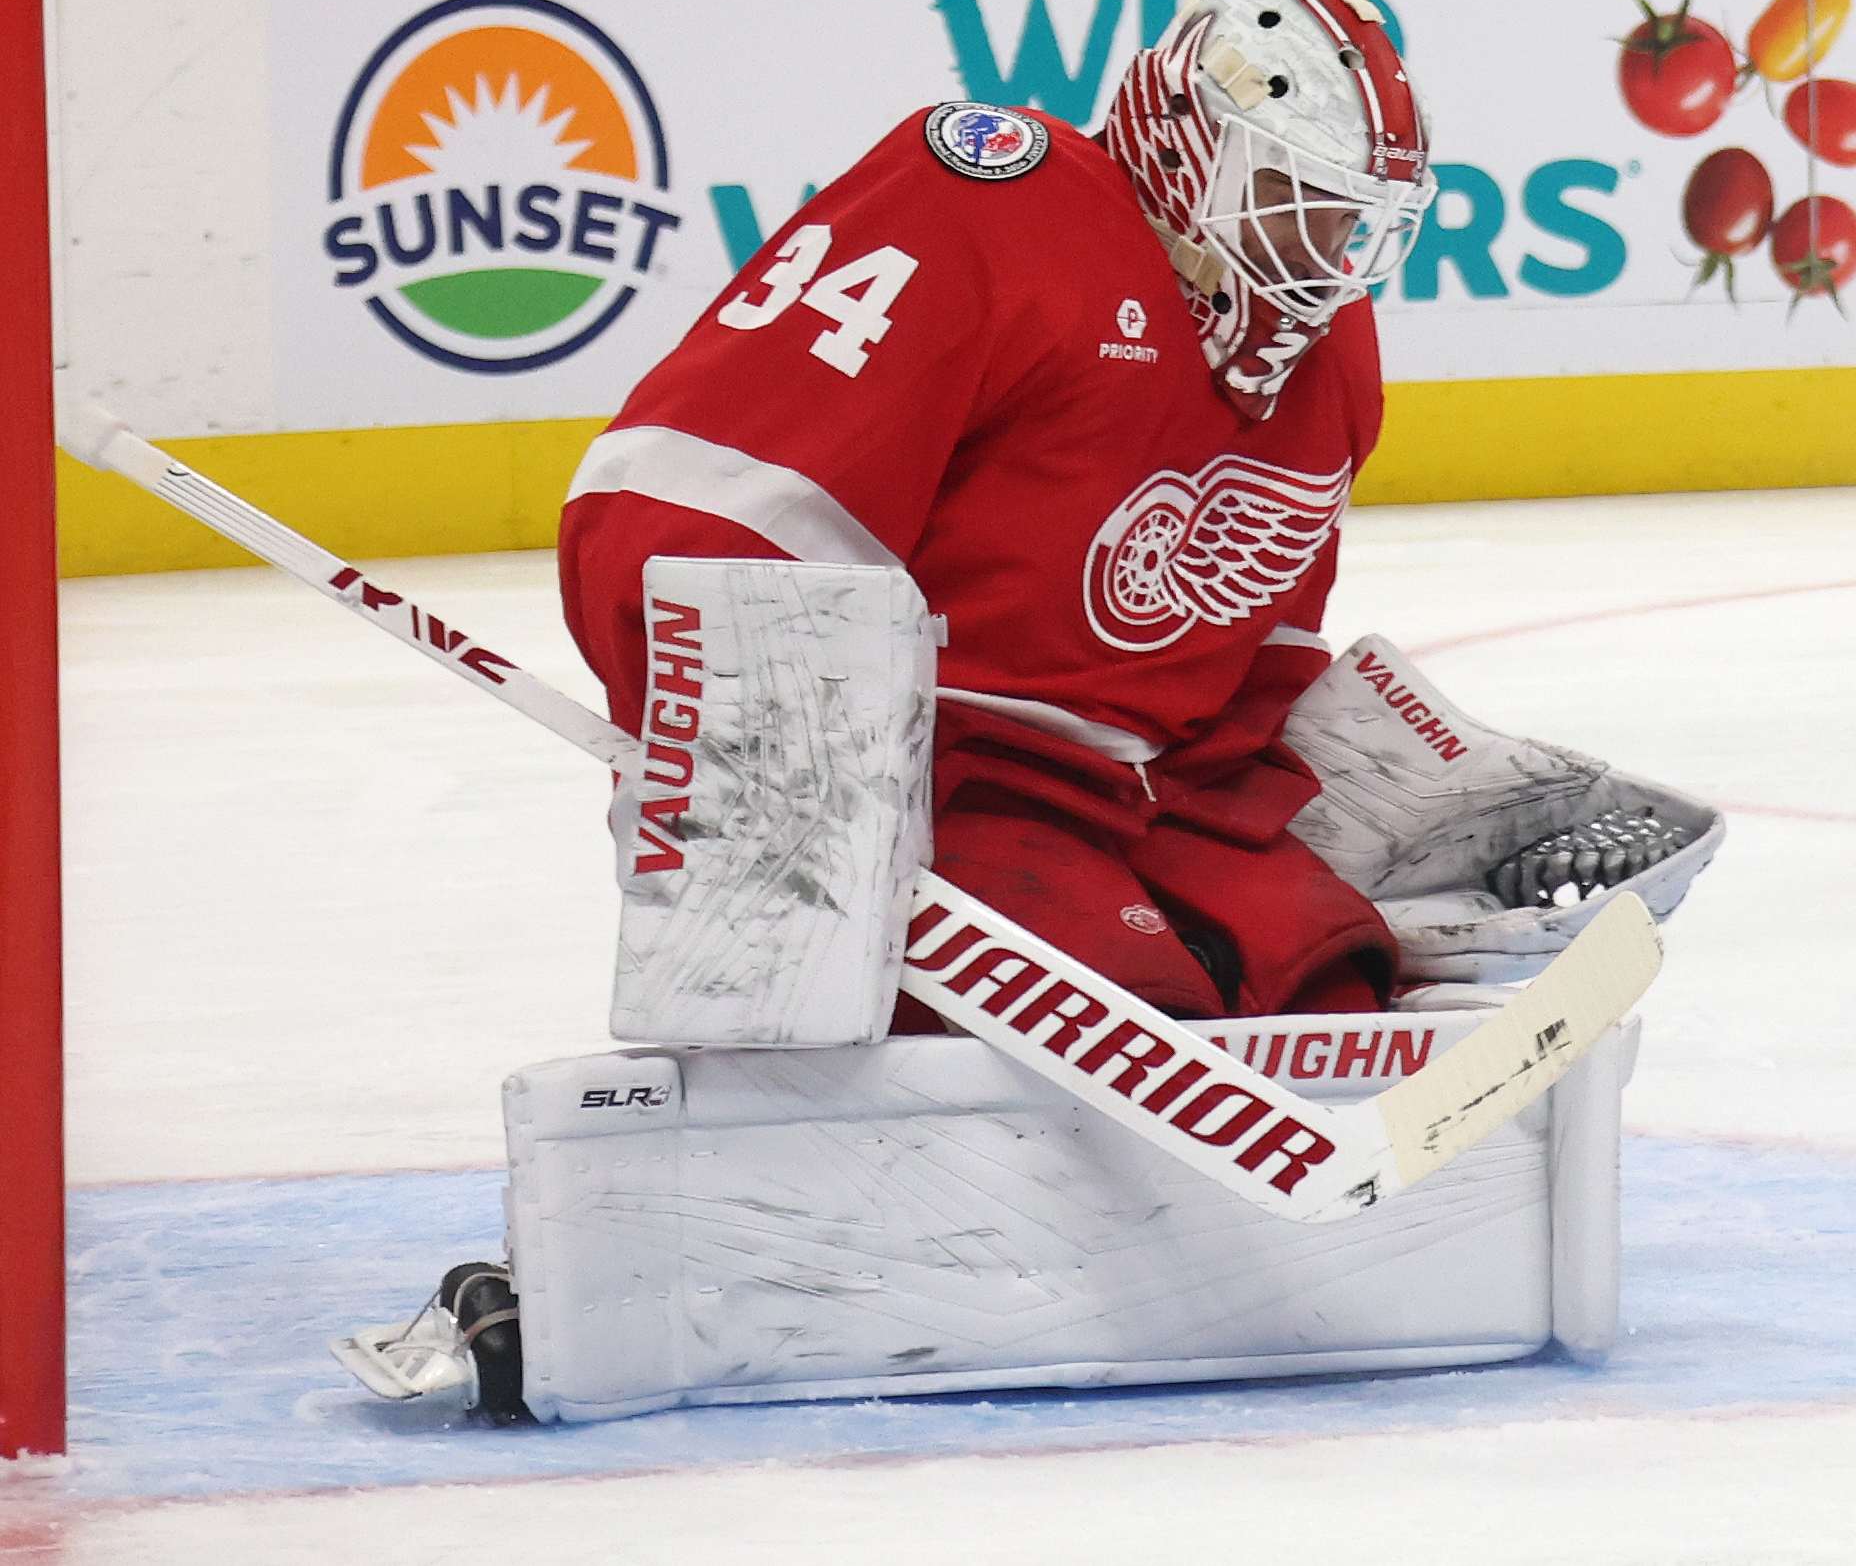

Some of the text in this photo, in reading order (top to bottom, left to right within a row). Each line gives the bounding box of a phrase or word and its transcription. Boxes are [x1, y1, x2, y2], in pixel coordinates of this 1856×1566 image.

[324, 183, 682, 289] SUNSET
[716, 224, 921, 379] 34
[1098, 343, 1159, 363] PRIORITY
[634, 596, 704, 876] VAUGHN
[1353, 653, 1468, 764] VAUGHN
[904, 902, 1338, 1197] WARRIOR
[1209, 1030, 1436, 1080] UGHN
